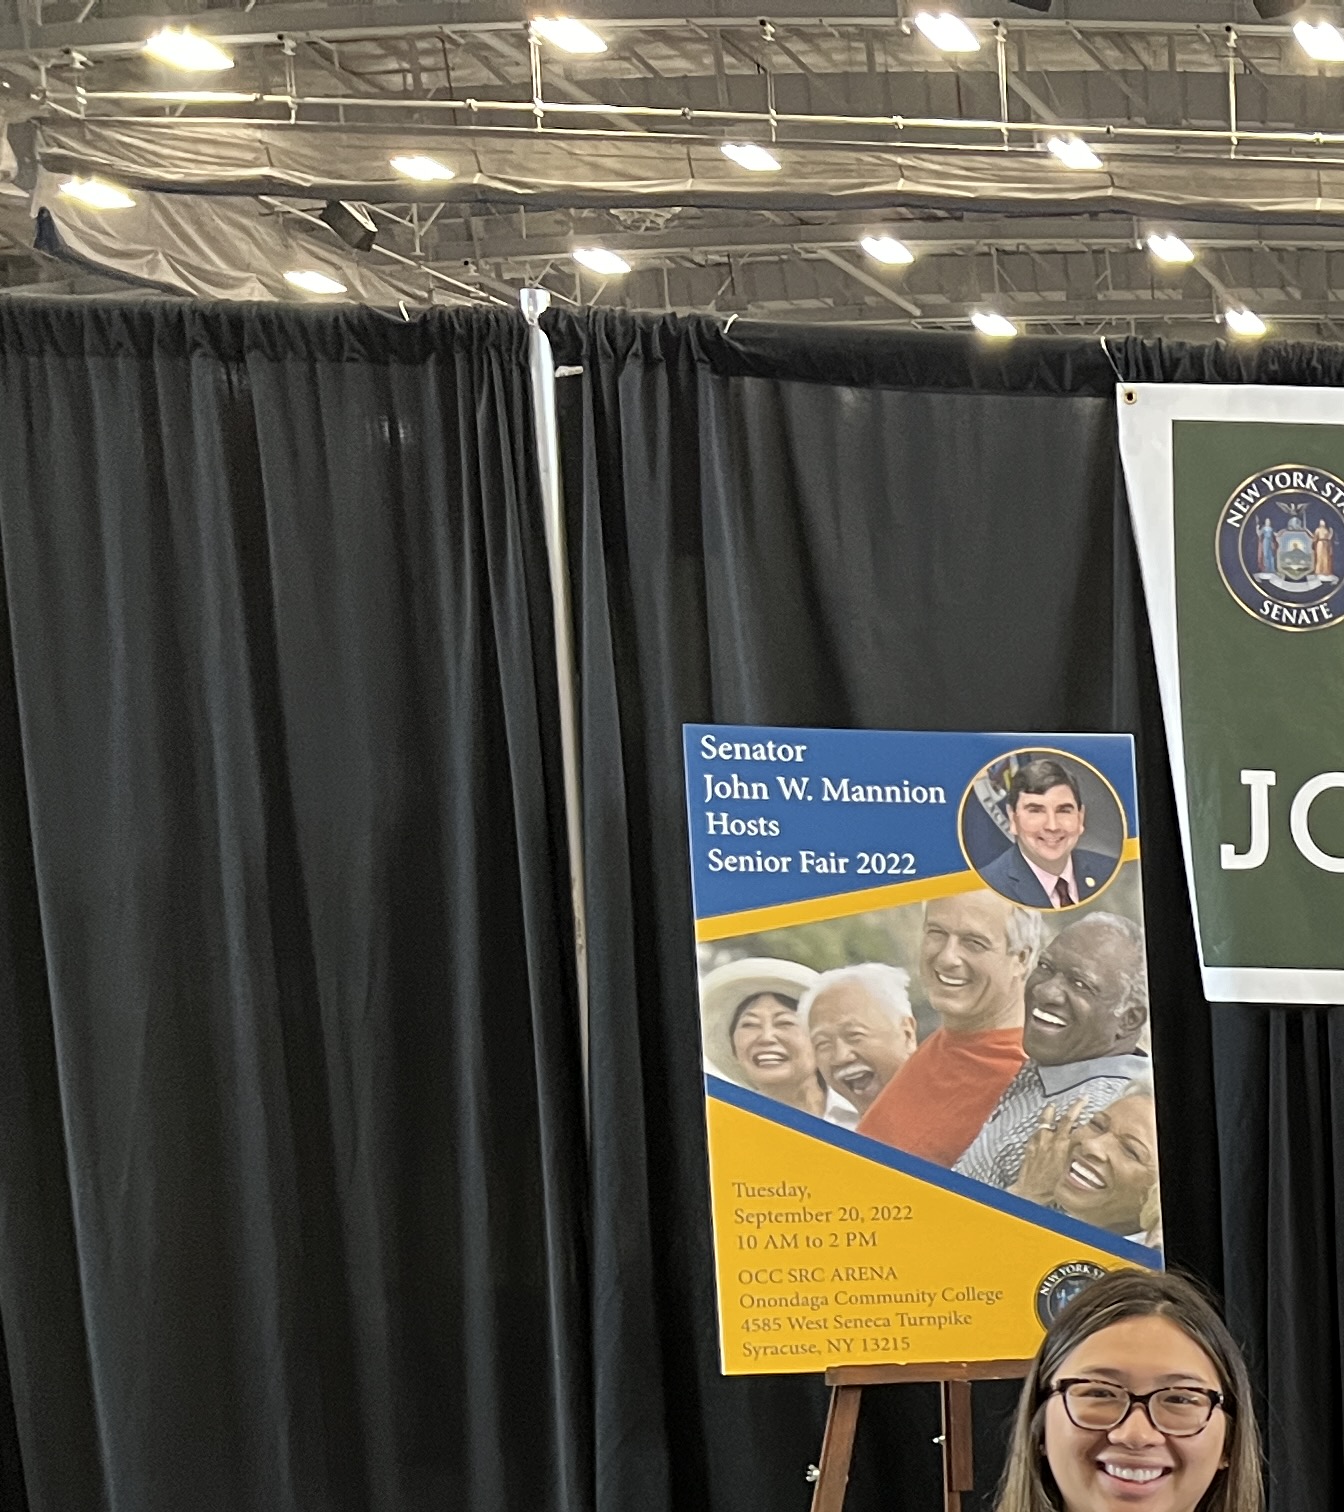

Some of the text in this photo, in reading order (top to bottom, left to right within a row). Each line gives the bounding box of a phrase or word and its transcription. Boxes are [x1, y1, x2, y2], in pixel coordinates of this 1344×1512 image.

[1227, 484, 1261, 528] NEW
[1262, 472, 1320, 492] YORK
[1260, 600, 1333, 624] SENATE
[700, 734, 807, 762] Senator
[704, 774, 946, 803] John W. Mannion
[706, 812, 780, 836] Hosts
[708, 848, 916, 874] Senior Fair 2022
[732, 1181, 811, 1201] Tuesday,
[734, 1205, 913, 1229] September 20, 2022
[738, 1231, 877, 1250] 10 AM to 2 PM
[738, 1266, 898, 1284] OCC SRC ARENA
[1040, 1272, 1059, 1296] NEW
[1059, 1264, 1090, 1275] YORK
[740, 1287, 1003, 1311] Onondaga Community College
[741, 1311, 972, 1332] 4585 West Seneca Turnpike
[742, 1337, 910, 1360] Syracuse, NY 13215
